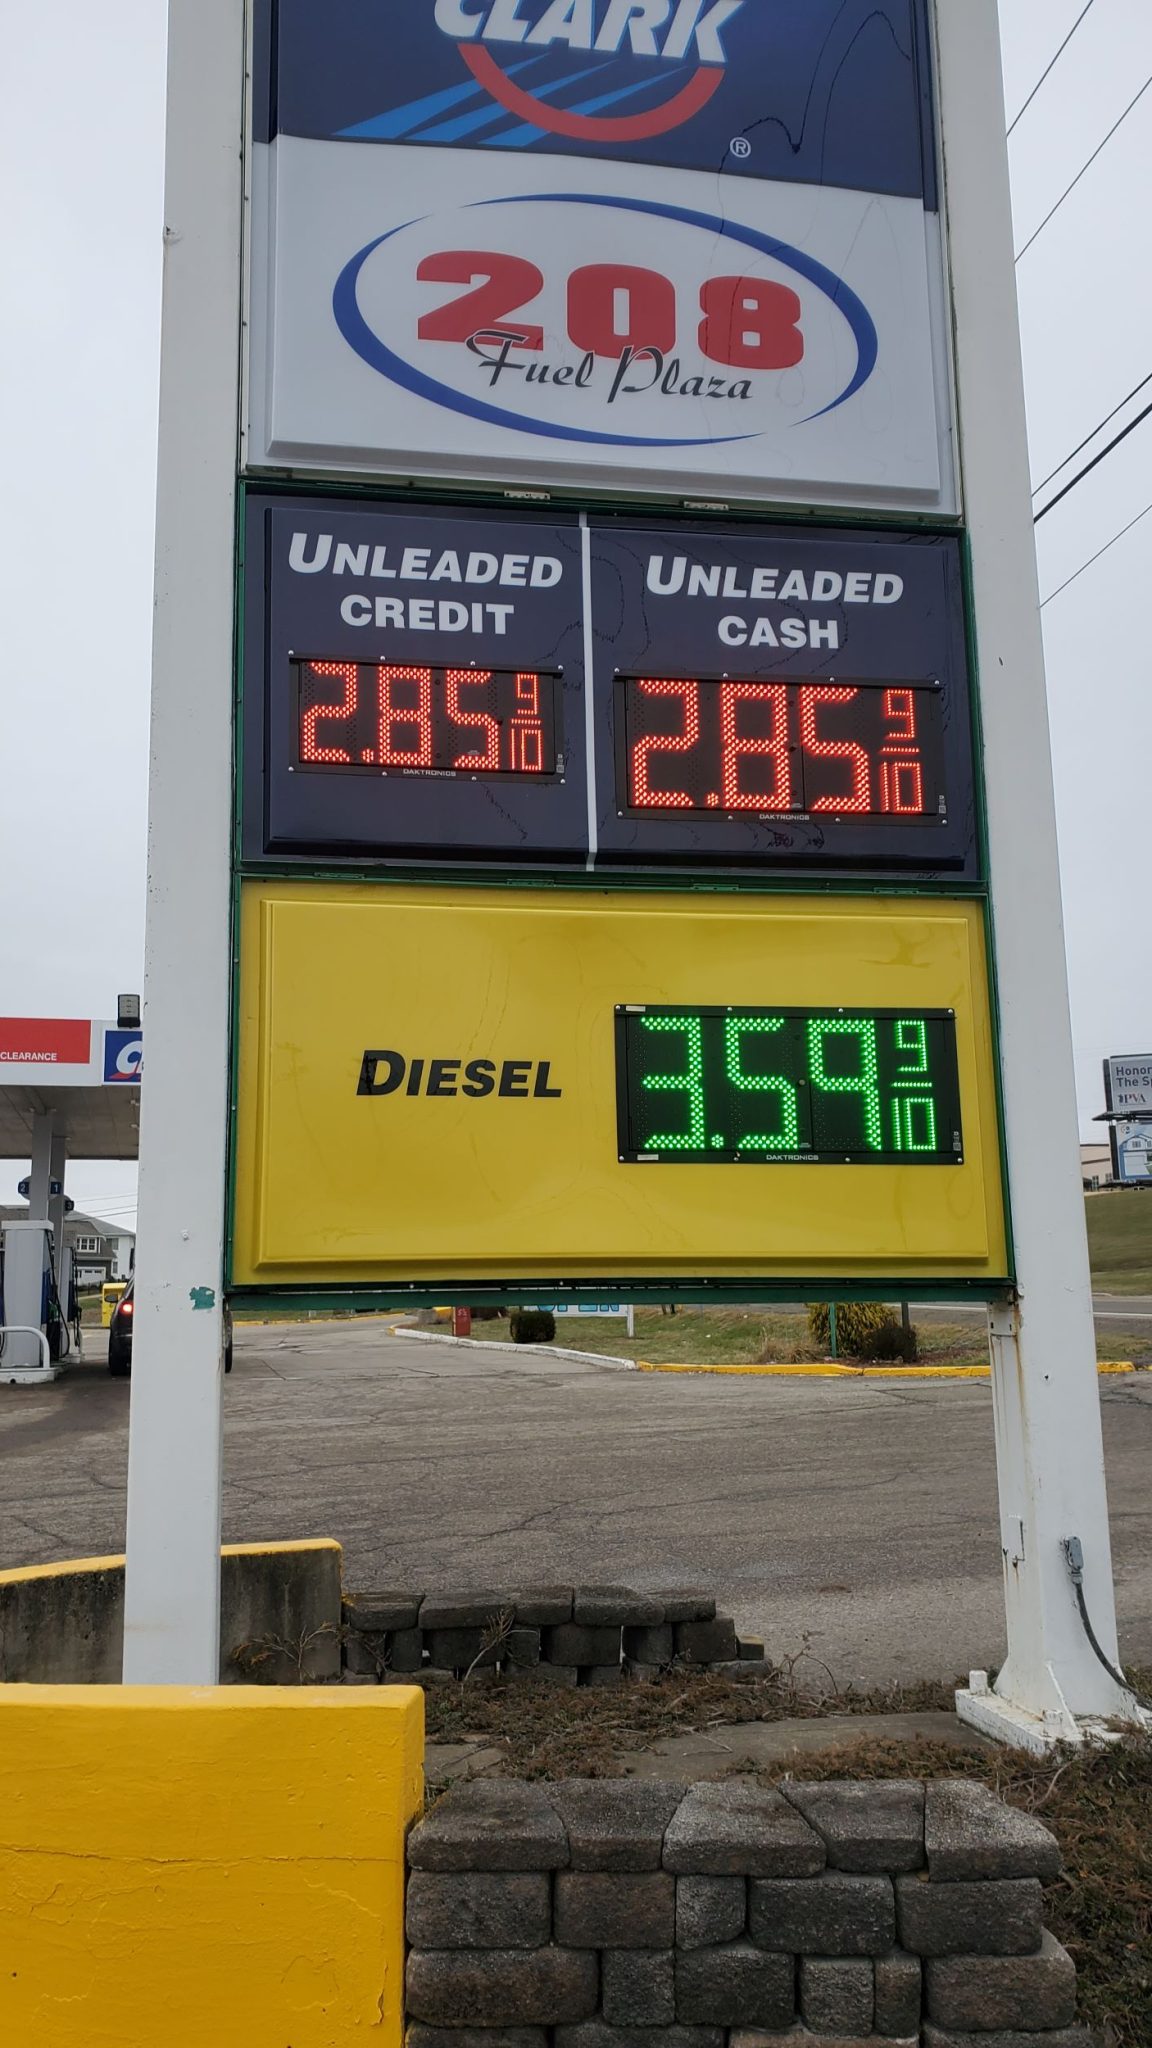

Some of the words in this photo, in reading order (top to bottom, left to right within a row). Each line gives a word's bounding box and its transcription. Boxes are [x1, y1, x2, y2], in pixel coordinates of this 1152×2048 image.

[433, 0, 744, 64] CLARK
[416, 250, 804, 370] 208
[465, 330, 594, 387] Fuel
[606, 345, 752, 403] Plaza
[288, 532, 563, 588] UNLEADED
[646, 555, 904, 604] UNLEADED
[340, 594, 515, 635] CREDIT
[717, 615, 839, 649] CASH
[303, 661, 500, 770] 2.85
[633, 679, 872, 812] 2.85
[403, 768, 456, 777] DAKTRONICS
[0, 1051, 58, 1061] CLEARANCE
[356, 1049, 563, 1098] DIESEL
[640, 1016, 883, 1151] 3.59
[1116, 1077, 1139, 1087] The
[20, 1183, 26, 1193] 2
